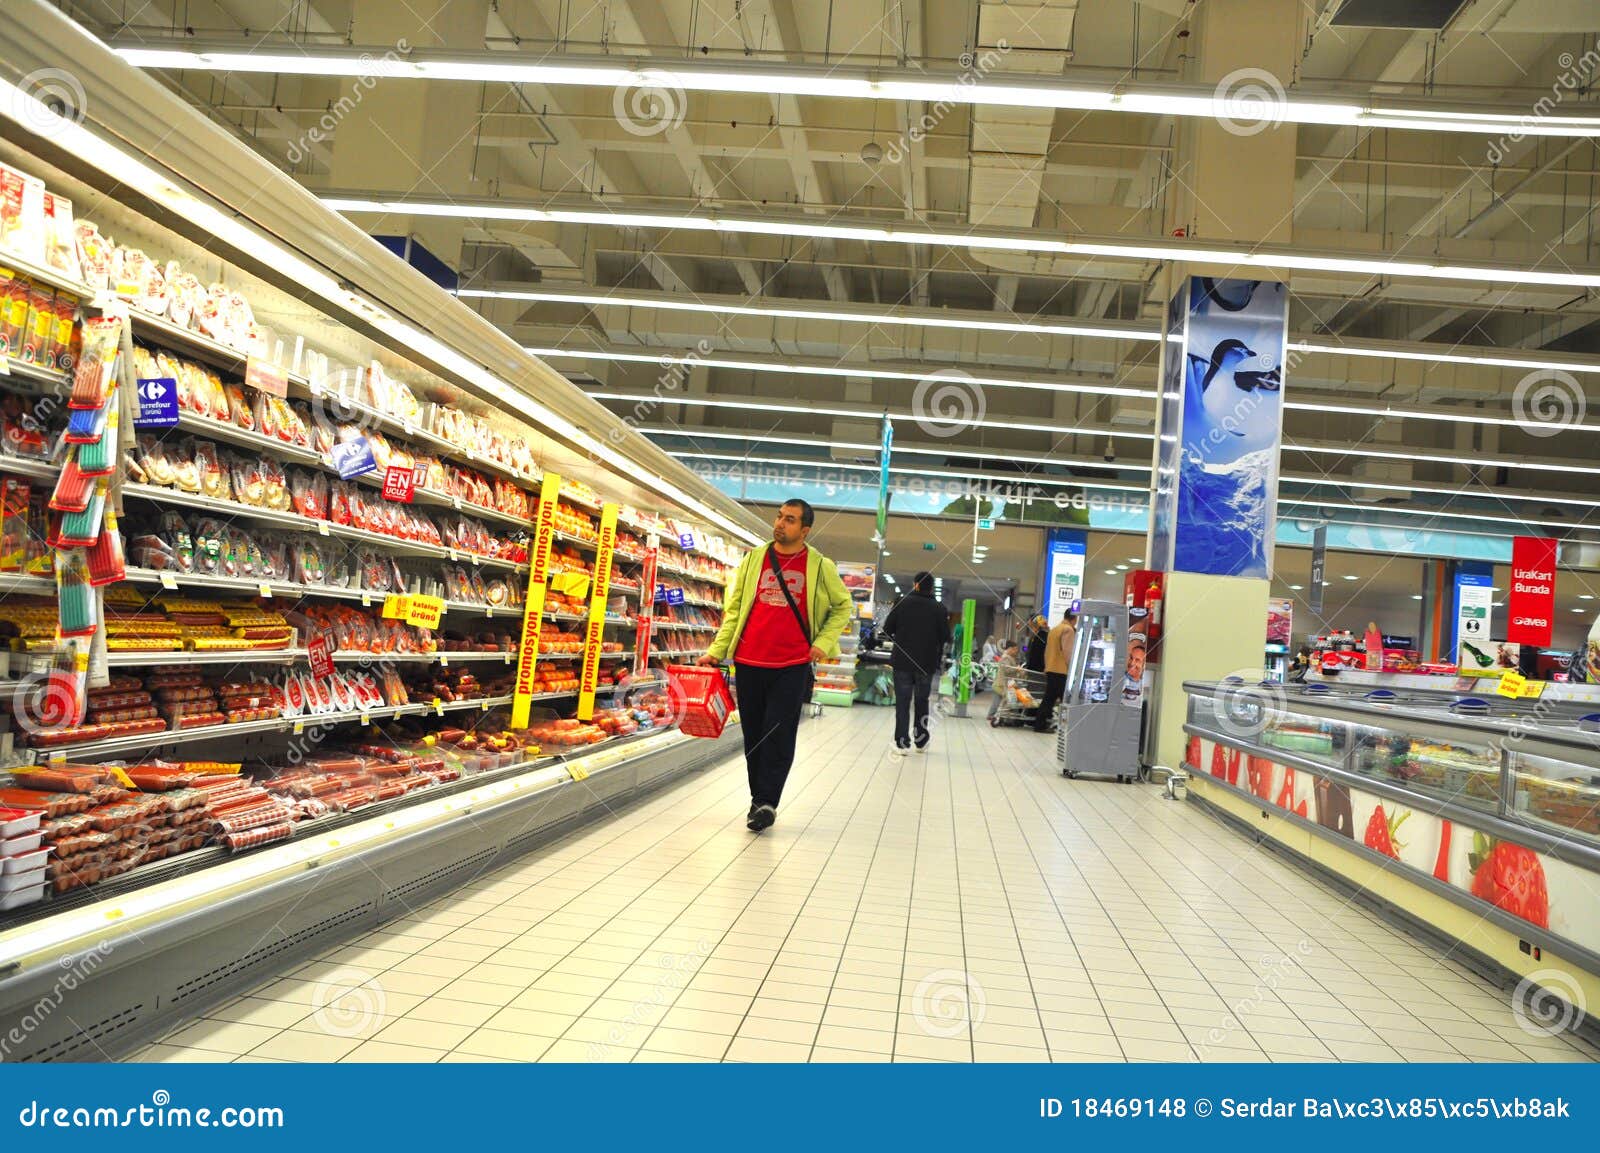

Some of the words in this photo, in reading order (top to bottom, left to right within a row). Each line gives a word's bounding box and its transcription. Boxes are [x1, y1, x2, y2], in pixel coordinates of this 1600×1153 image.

[387, 472, 410, 490] EN
[385, 487, 407, 496] UCUZ
[1054, 486, 1145, 514] ederiz
[532, 500, 554, 584] promosyon
[595, 526, 612, 597] promosyon
[1515, 582, 1551, 595] Burada
[412, 600, 439, 614] katalog
[411, 611, 436, 622] ürünü
[1523, 617, 1548, 628] avea
[517, 611, 539, 695] promosyon
[582, 621, 600, 693] promosyon
